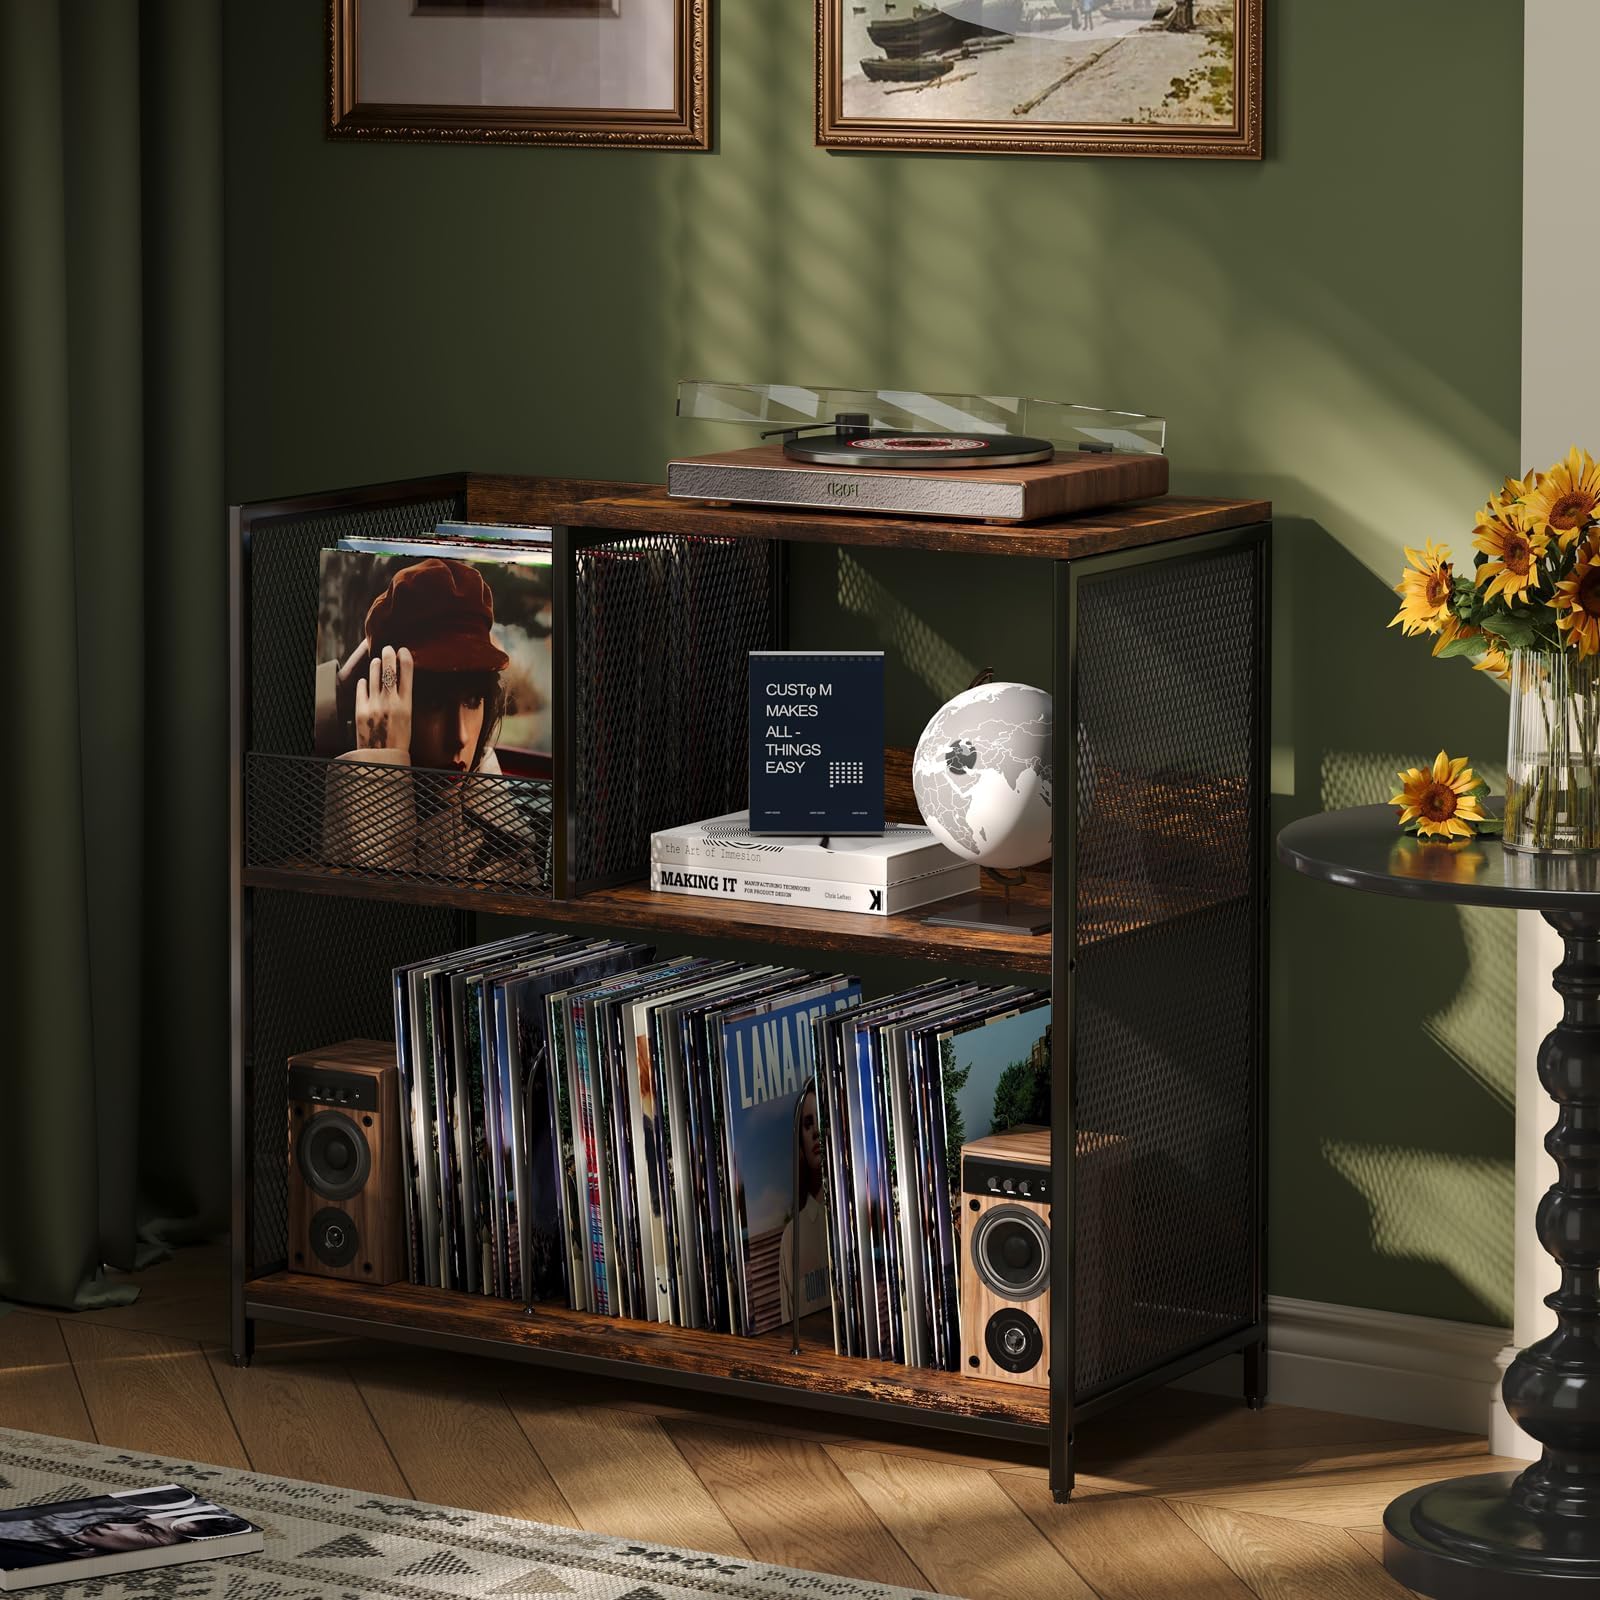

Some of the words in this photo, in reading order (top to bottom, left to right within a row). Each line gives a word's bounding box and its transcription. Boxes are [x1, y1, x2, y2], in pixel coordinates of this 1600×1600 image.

[765, 704, 819, 717] MAKES
[765, 743, 822, 756] THINGS
[765, 761, 806, 774] EASY
[665, 843, 681, 854] the
[684, 845, 701, 856] Art
[705, 847, 716, 858] of
[721, 848, 761, 862] Immesion
[660, 870, 719, 891] MAKING
[722, 877, 738, 893] IT
[744, 880, 783, 889] MANUFACTURING
[783, 884, 811, 892] TECHNIQUES
[735, 1015, 798, 1110] LANA
